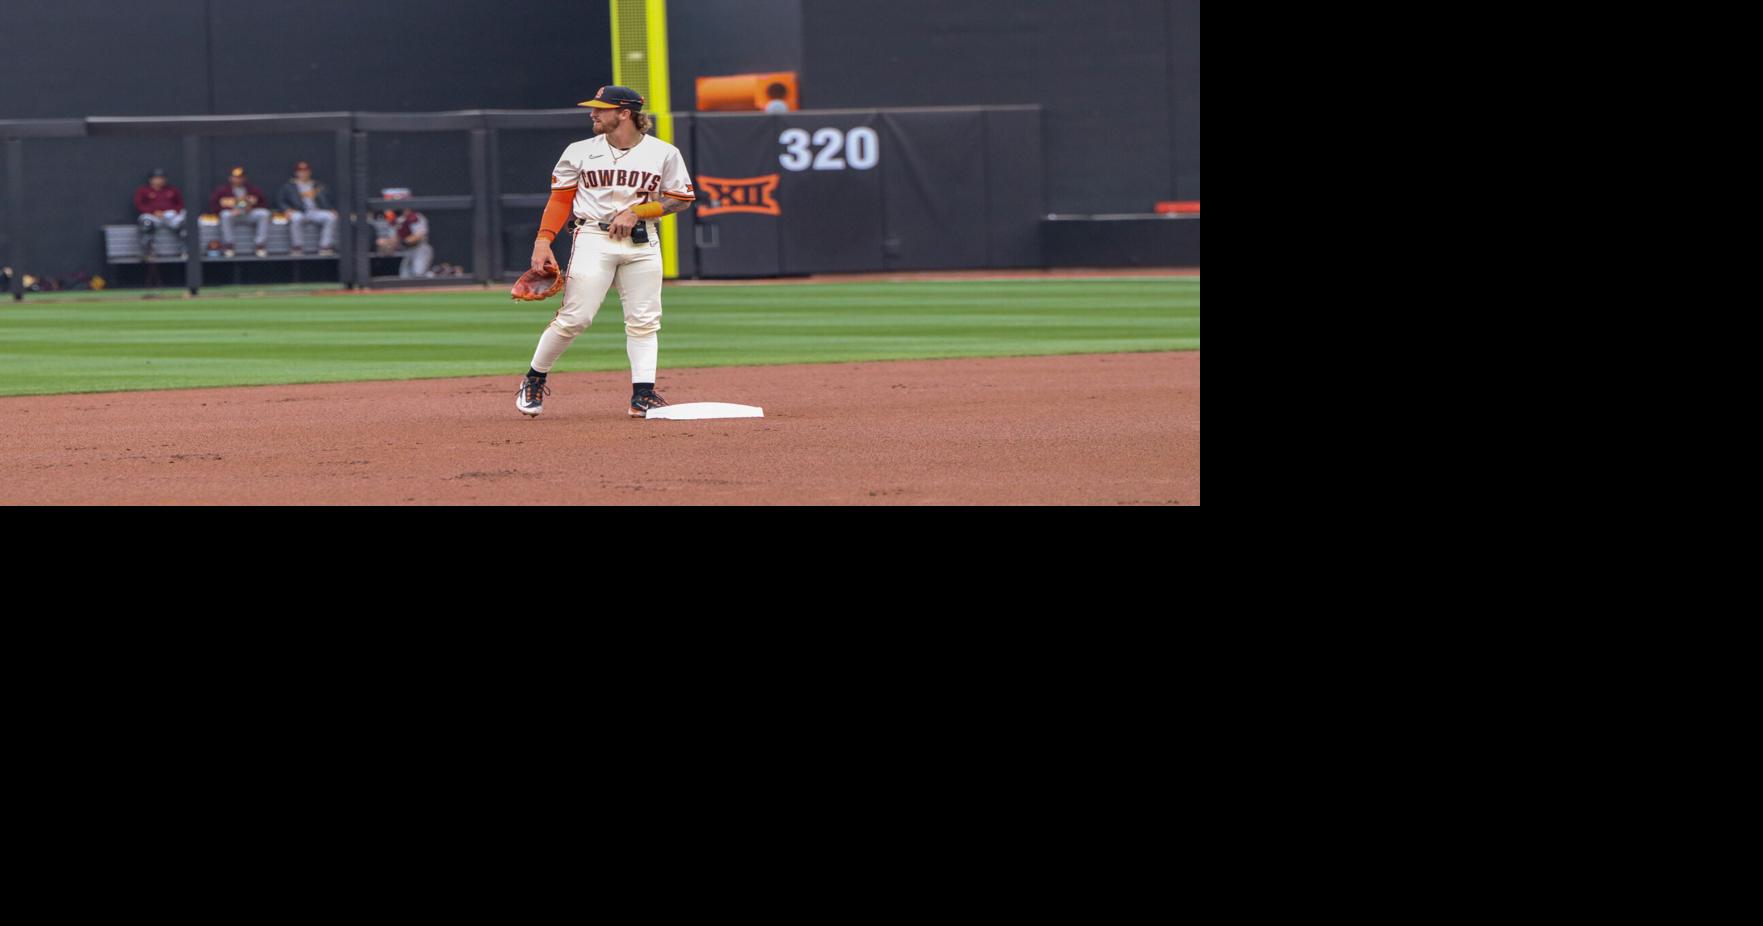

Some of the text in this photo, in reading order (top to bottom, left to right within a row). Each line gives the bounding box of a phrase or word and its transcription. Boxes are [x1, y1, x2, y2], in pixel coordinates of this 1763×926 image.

[778, 127, 879, 171] 320
[580, 169, 661, 192] COWBOYS
[636, 191, 649, 205] 7
[707, 181, 771, 208] XII
